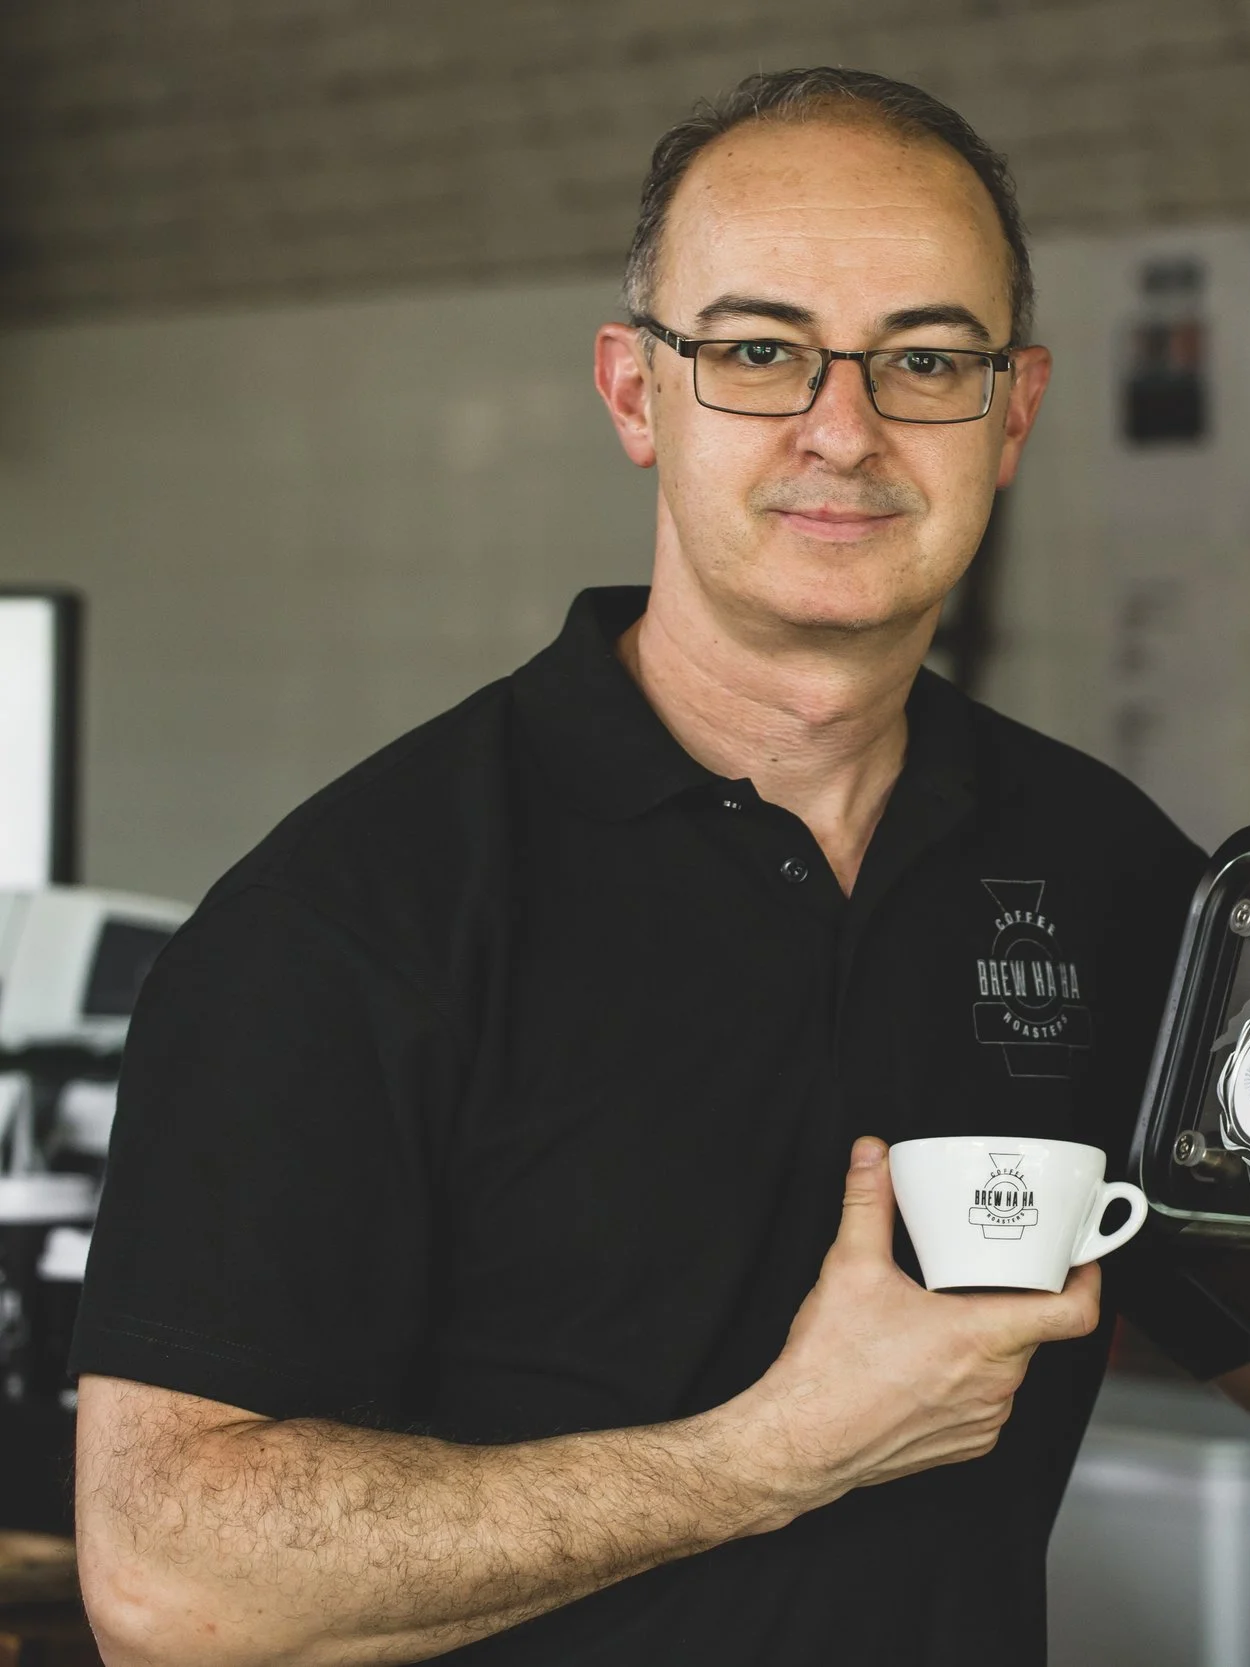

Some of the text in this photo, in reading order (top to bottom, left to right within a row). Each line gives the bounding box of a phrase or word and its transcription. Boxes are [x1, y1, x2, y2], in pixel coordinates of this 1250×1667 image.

[995, 910, 1056, 936] COFFEE
[977, 959, 1080, 999] BREW HA HA
[1003, 1012, 1068, 1038] ROASTERS
[990, 1168, 1025, 1180] COFFEE
[975, 1190, 1034, 1207] BREW HA HA
[987, 1212, 1025, 1224] ROASTERS
